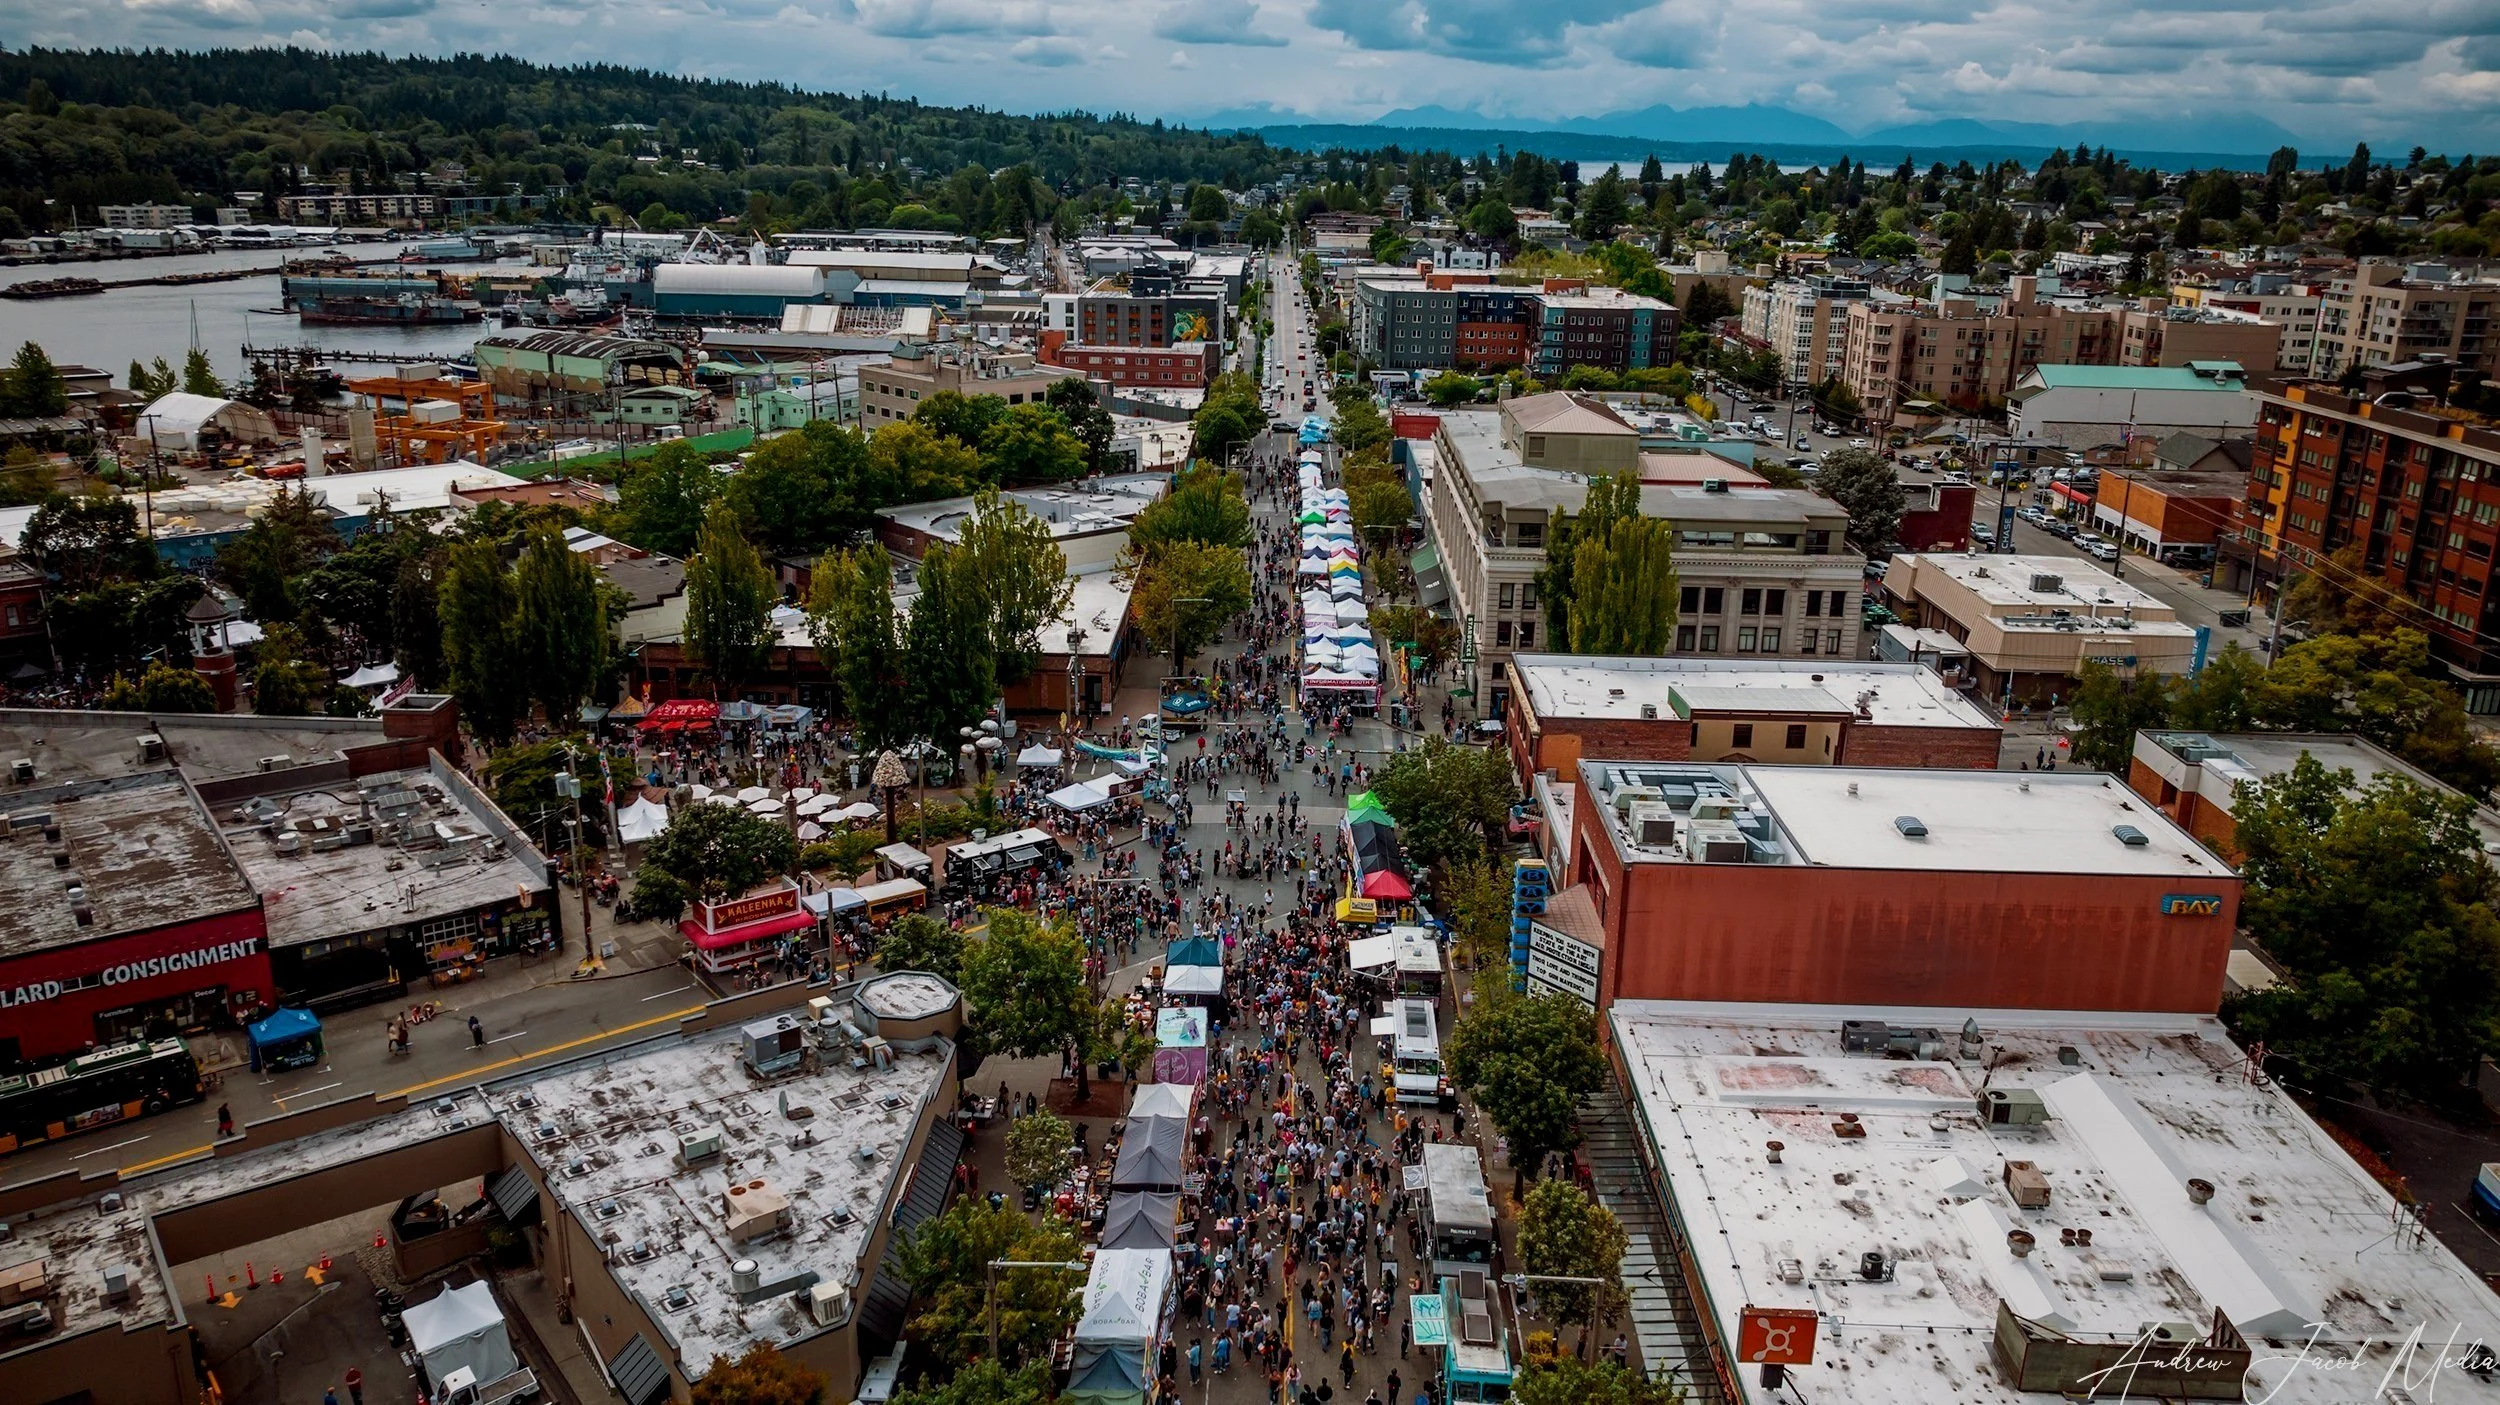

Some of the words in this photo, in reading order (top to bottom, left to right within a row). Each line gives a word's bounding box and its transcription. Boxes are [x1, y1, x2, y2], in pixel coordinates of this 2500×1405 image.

[2001, 518, 2012, 549] CHASE
[1466, 617, 1474, 657] STARBUCKS
[2187, 639, 2199, 680] CHASE
[728, 896, 784, 917] KALEENKA
[2170, 899, 2221, 915] BAY
[1533, 927, 1554, 940] KEEPING
[1566, 942, 1581, 953] SAFE
[1539, 936, 1555, 949] STATE
[102, 937, 258, 986] CONSIGNMENT
[1532, 954, 1546, 965] THOR
[1546, 961, 1559, 971] LOVE
[1536, 966, 1546, 975] TOP
[194, 988, 216, 998] Decor
[99, 1007, 134, 1019] Furniture
[1135, 1285, 1148, 1313] BOBA
[1142, 1257, 1155, 1278] BAR
